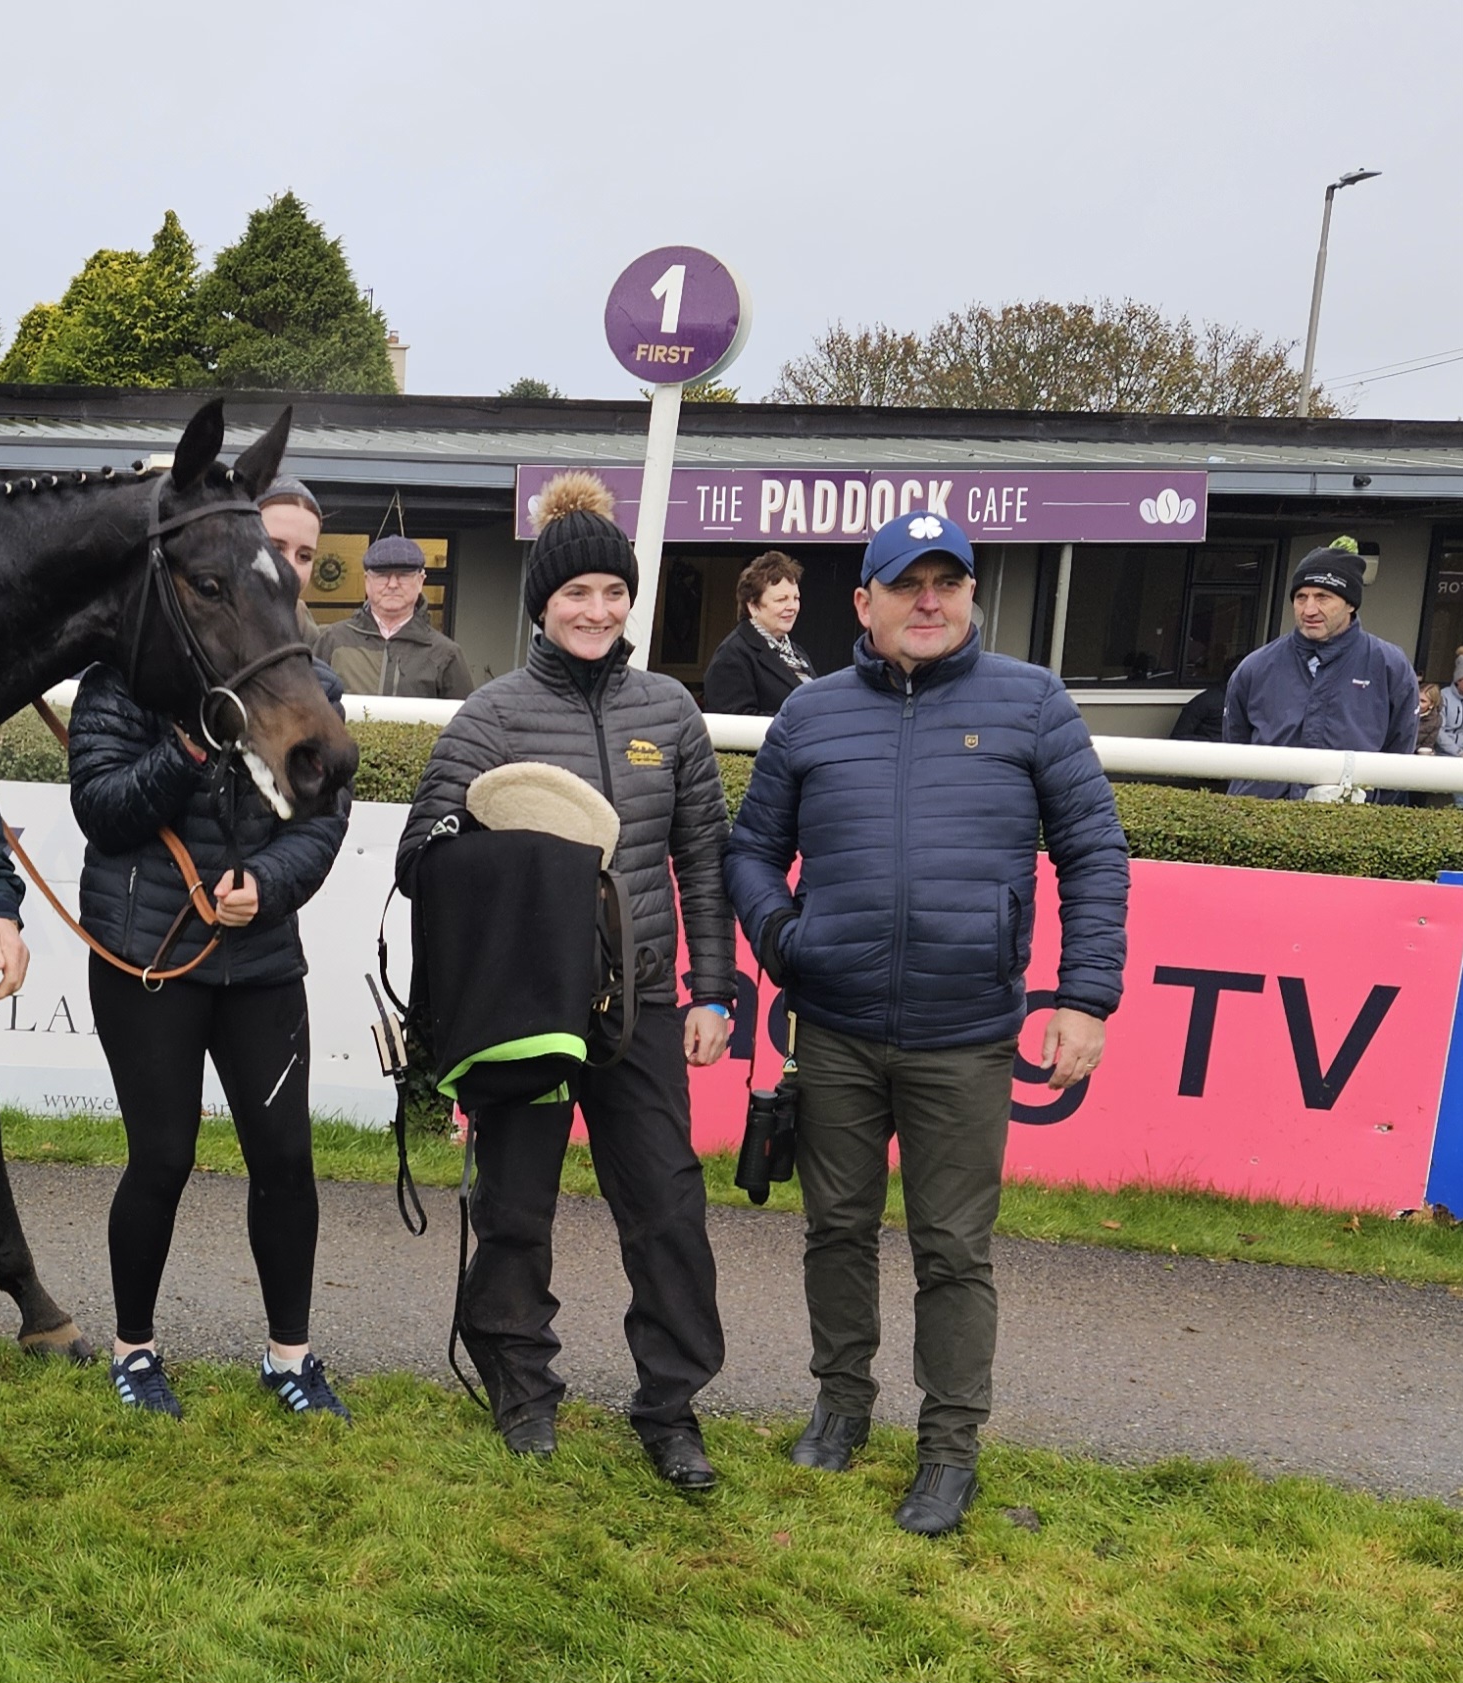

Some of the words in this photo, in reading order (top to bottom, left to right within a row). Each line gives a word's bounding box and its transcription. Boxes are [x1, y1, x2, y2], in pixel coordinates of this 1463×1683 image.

[650, 264, 687, 334] 1
[635, 343, 695, 365] FIRST
[696, 486, 743, 522] THE
[759, 479, 954, 534] PADDOCK
[967, 486, 1029, 523] CAFE
[1152, 965, 1402, 1111] TV
